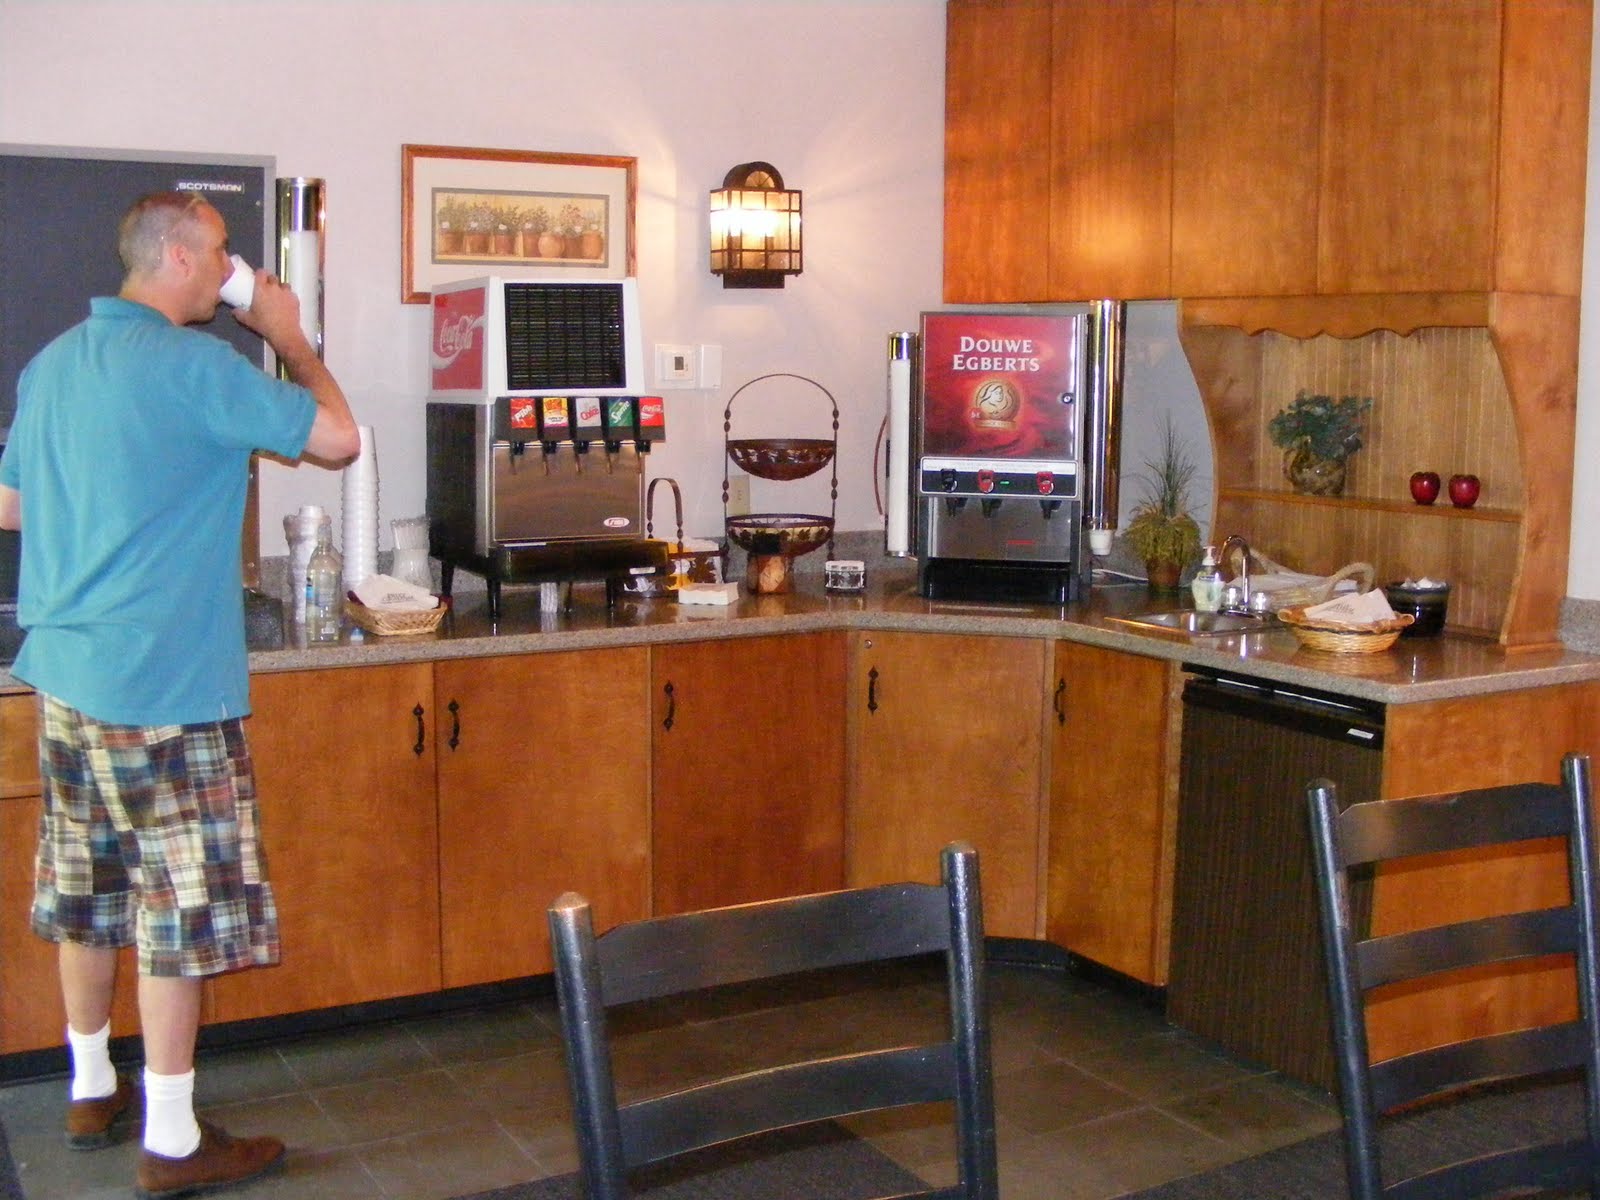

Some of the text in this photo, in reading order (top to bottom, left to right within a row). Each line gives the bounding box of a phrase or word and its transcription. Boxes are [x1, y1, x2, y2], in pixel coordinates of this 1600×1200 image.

[178, 182, 242, 192] SCOTSMAN
[960, 336, 1033, 353] DOUWE
[953, 354, 1040, 372] EGBERTS
